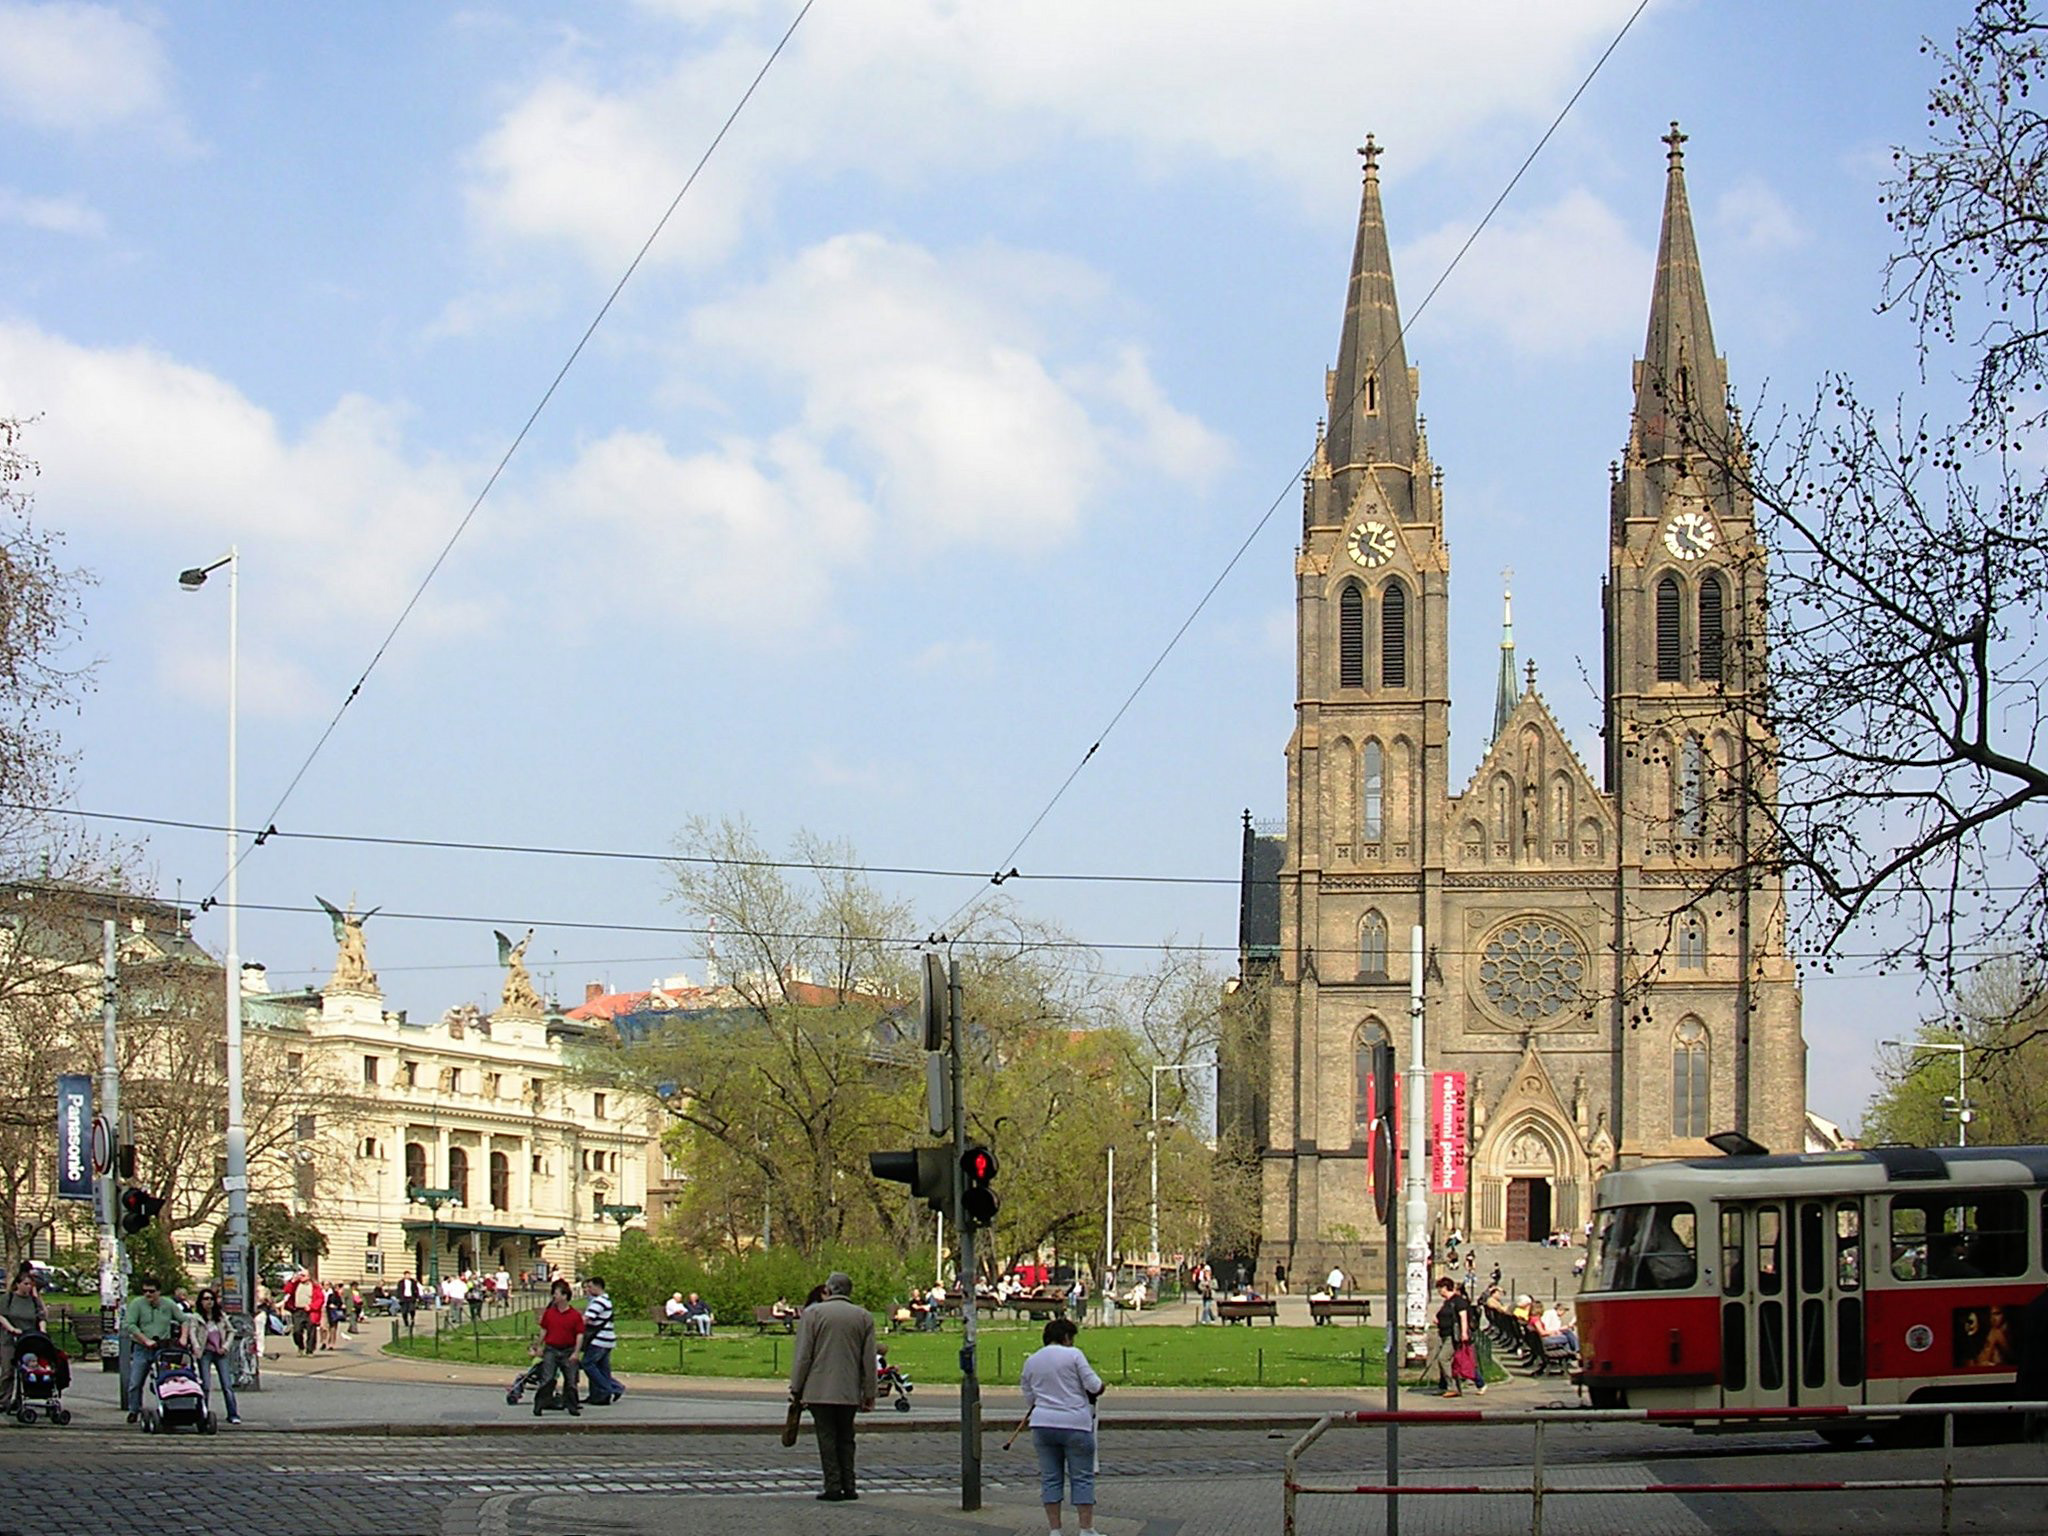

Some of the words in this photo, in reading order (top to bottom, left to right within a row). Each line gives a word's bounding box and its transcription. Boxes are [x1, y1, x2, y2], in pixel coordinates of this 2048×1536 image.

[1456, 1090, 1465, 1111] 261
[68, 1094, 85, 1182] Panasonic
[1456, 1116, 1465, 1138] 341
[1440, 1141, 1457, 1189] plocha
[1456, 1144, 1465, 1166] 122
